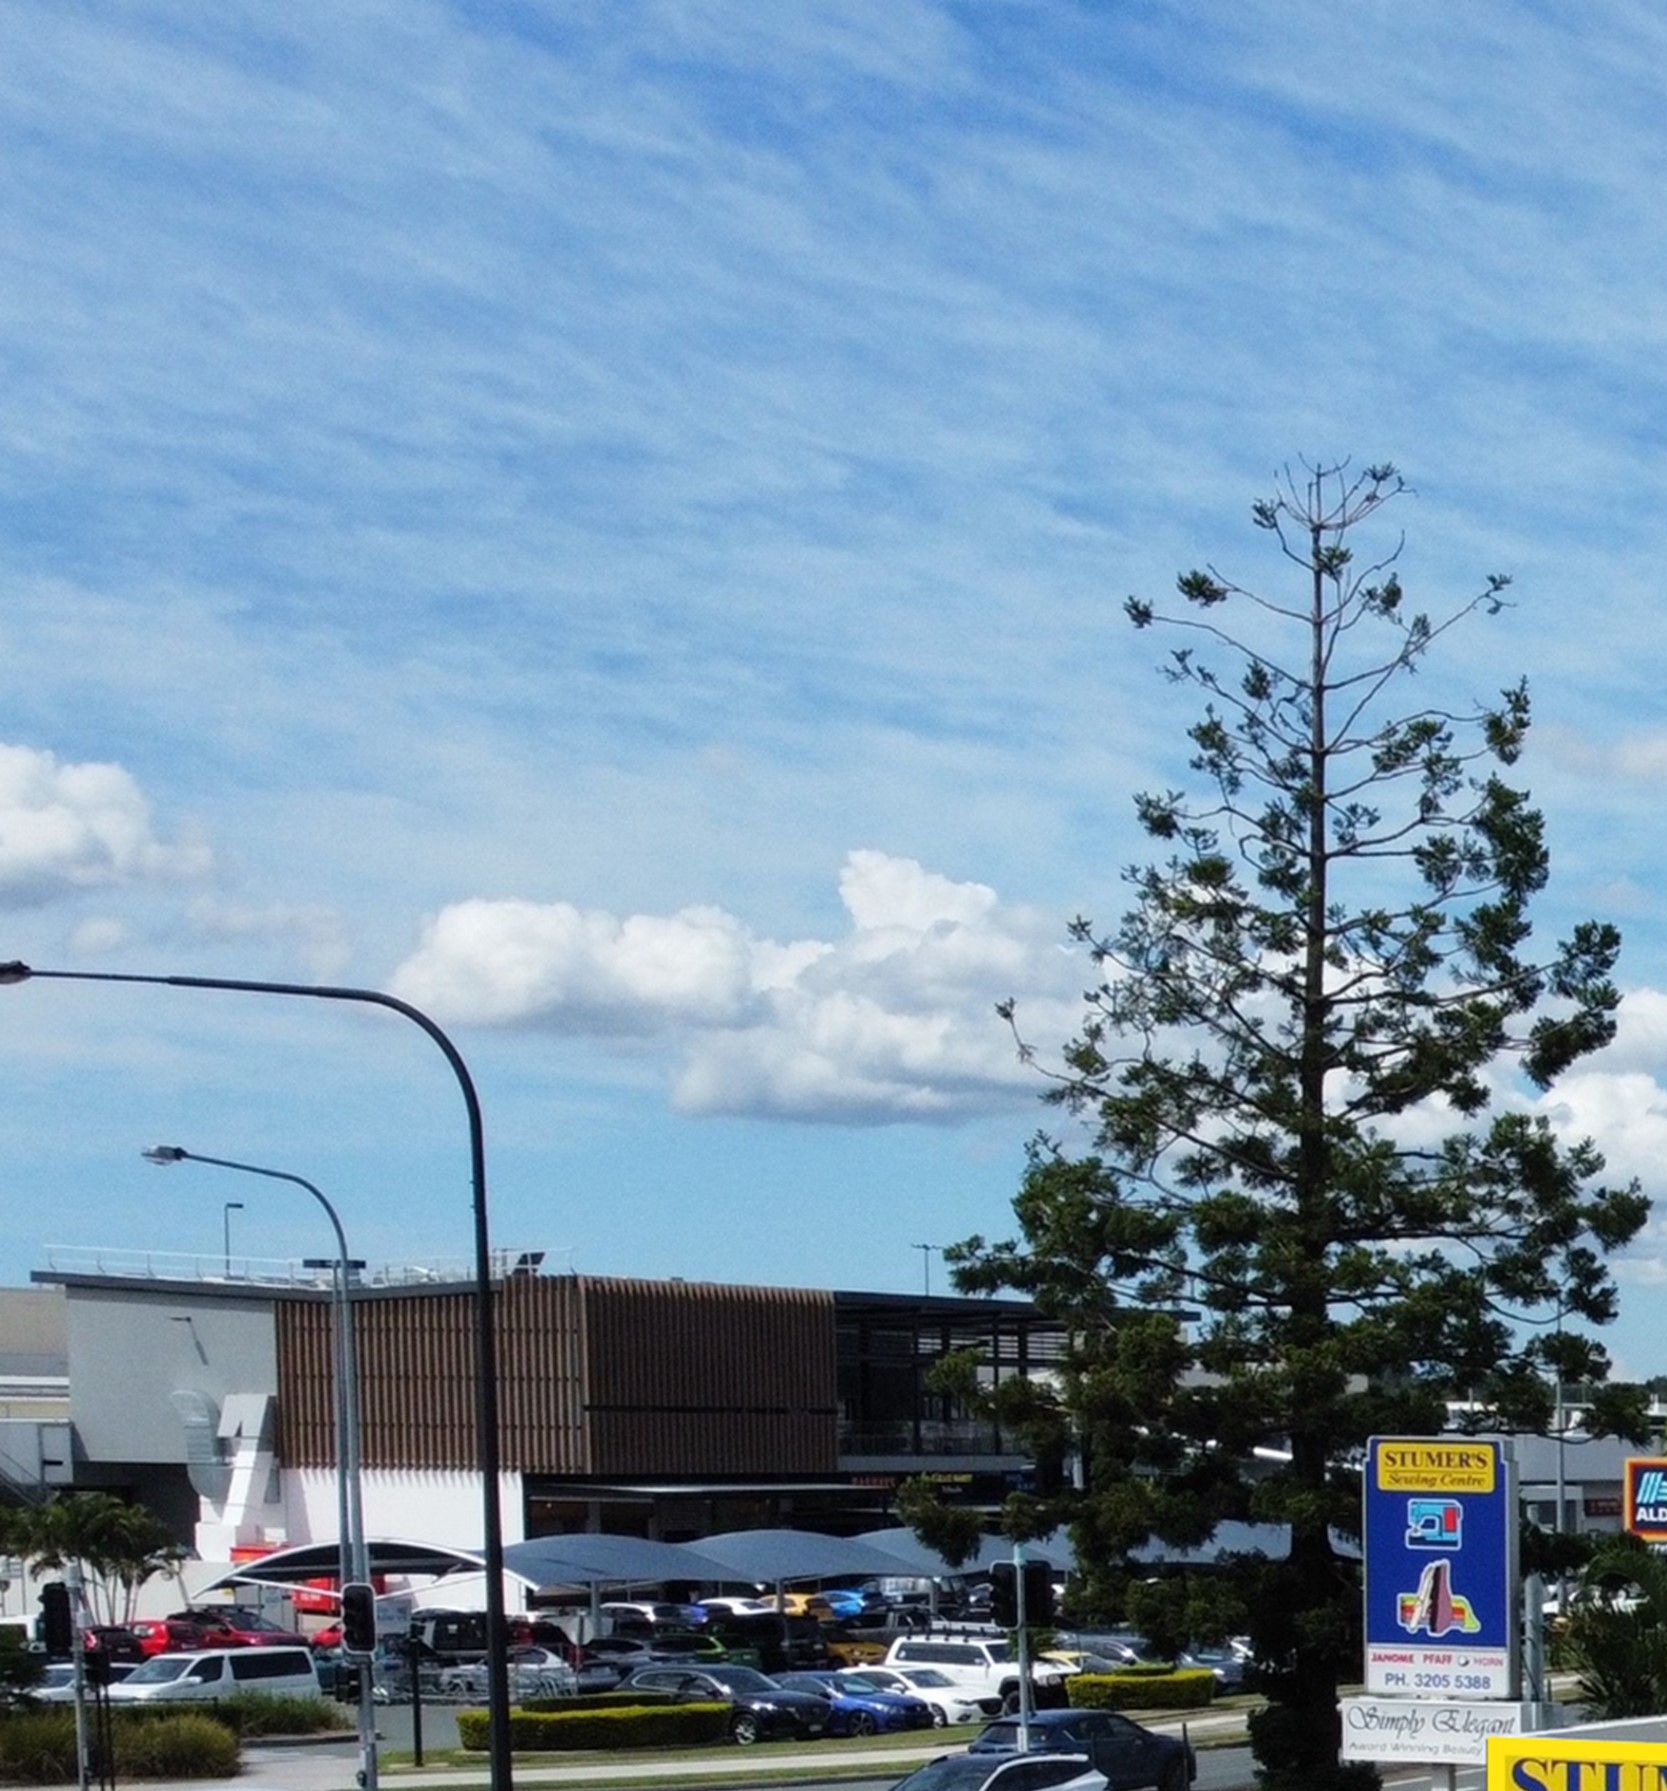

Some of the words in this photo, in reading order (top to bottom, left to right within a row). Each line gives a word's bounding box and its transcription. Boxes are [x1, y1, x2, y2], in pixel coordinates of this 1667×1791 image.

[1385, 1451, 1488, 1469] STUMER'S
[1389, 1474, 1437, 1487] Sewing
[1440, 1474, 1485, 1487] Centre
[1371, 1653, 1414, 1664] JANOME
[1423, 1654, 1452, 1664] PFAFF
[1474, 1656, 1504, 1667] HORN
[1385, 1673, 1409, 1686] PH.
[1414, 1673, 1450, 1688] 3205
[1455, 1675, 1491, 1689] 5388
[1349, 1706, 1426, 1739] Simply
[1432, 1709, 1515, 1742] Elegant
